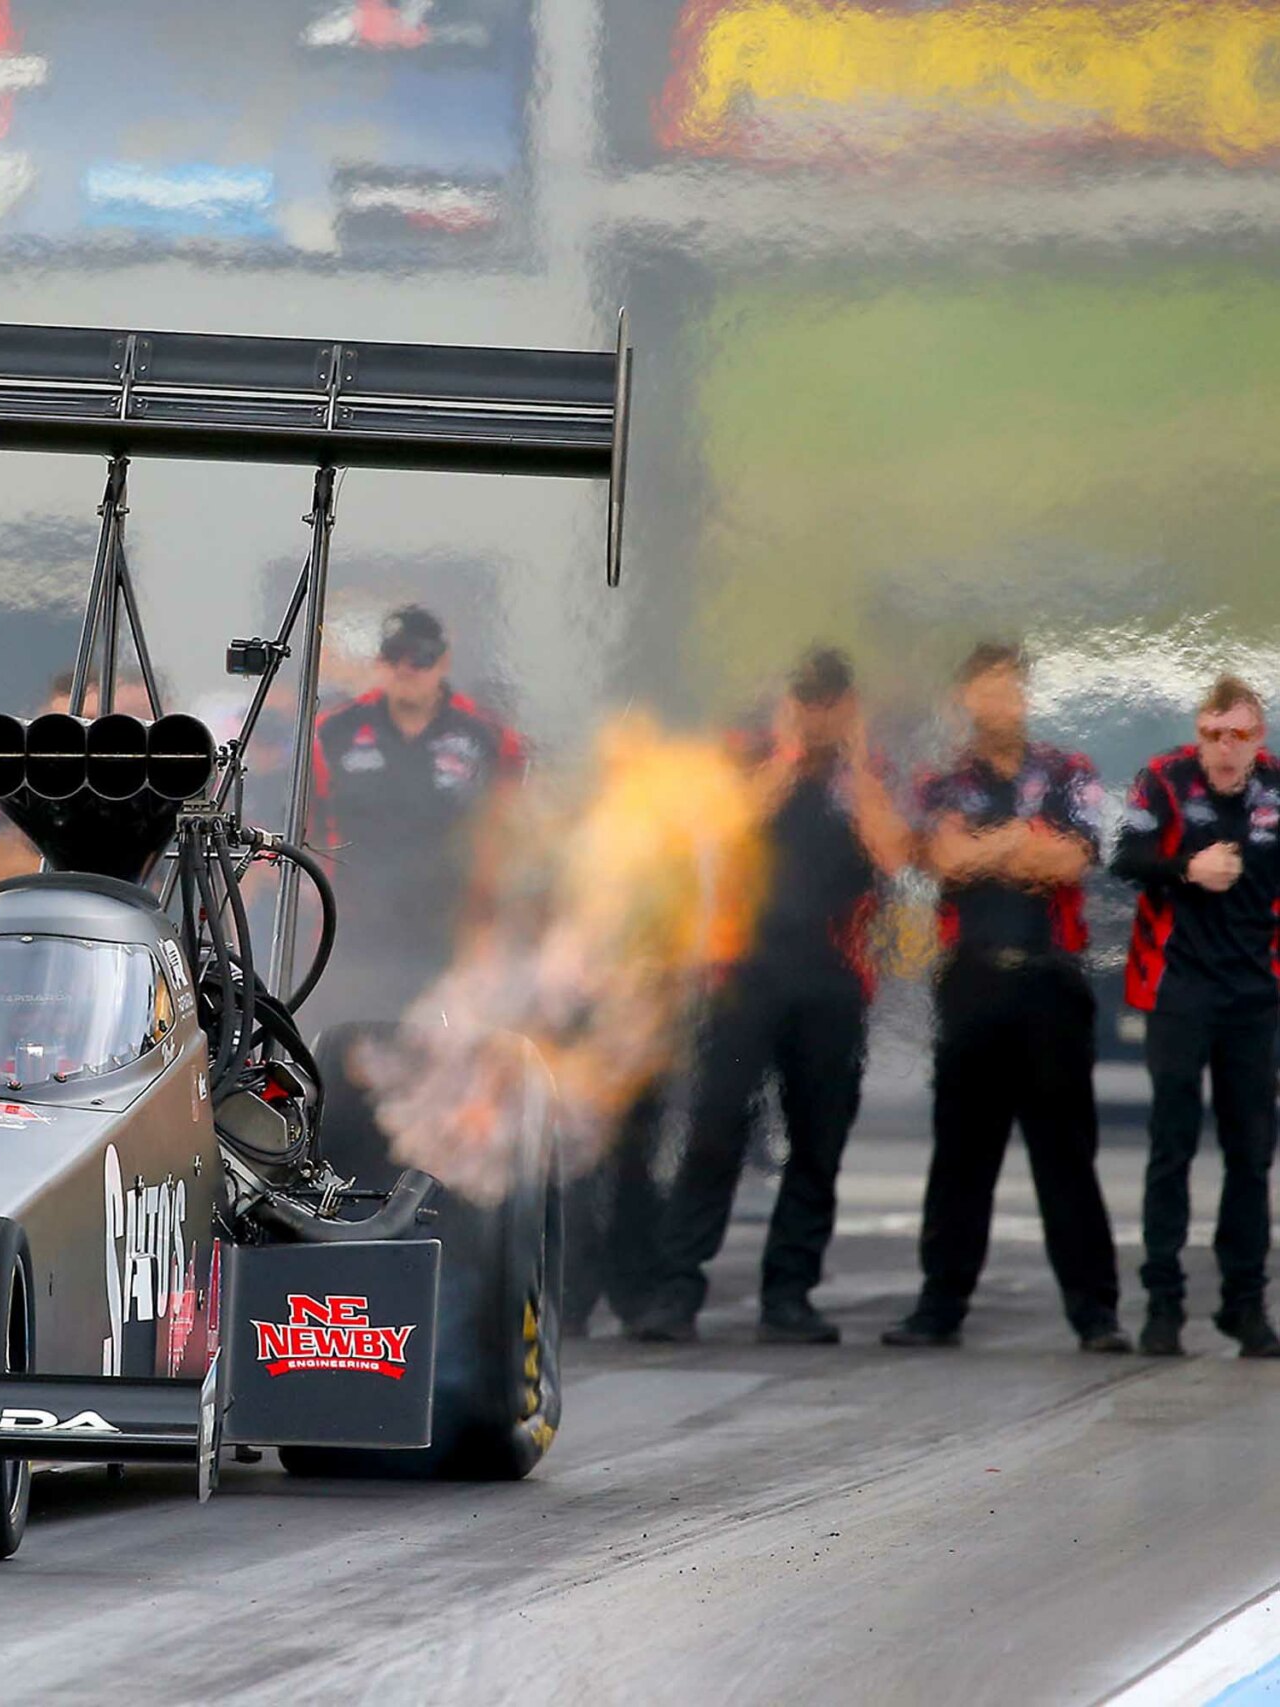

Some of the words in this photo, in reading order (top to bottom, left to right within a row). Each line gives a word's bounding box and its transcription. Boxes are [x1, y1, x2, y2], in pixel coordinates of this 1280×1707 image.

[287, 1294, 370, 1328] NE
[249, 1319, 417, 1364] NEWBY
[287, 1359, 381, 1371] ENGINEERING
